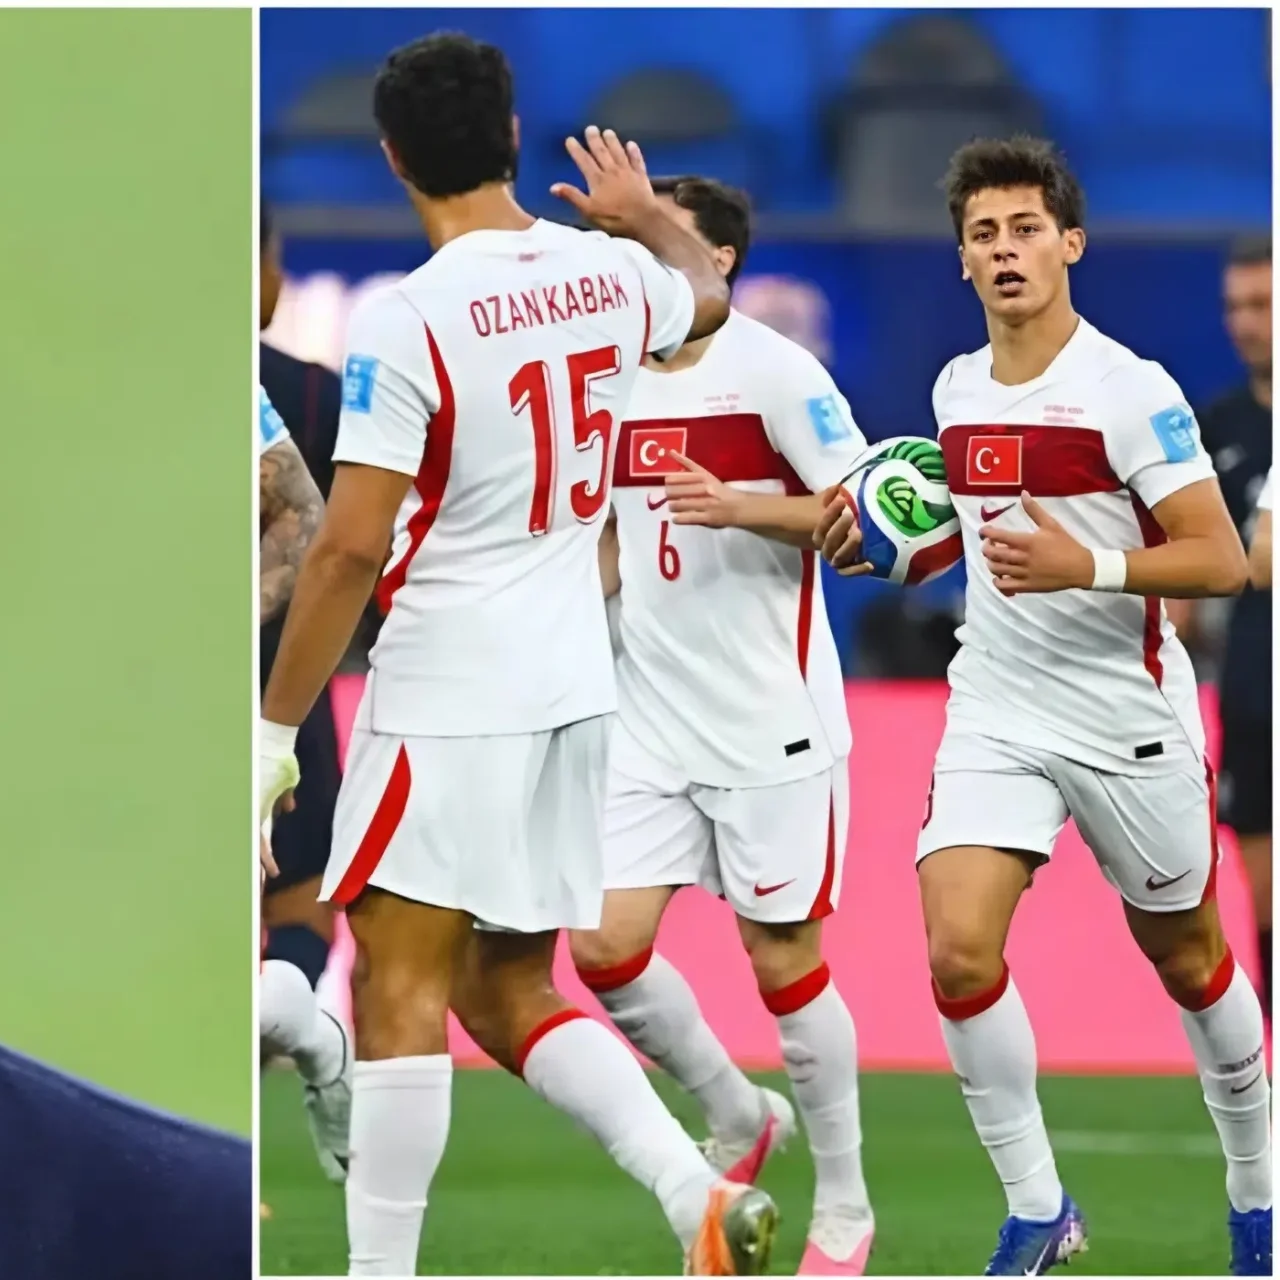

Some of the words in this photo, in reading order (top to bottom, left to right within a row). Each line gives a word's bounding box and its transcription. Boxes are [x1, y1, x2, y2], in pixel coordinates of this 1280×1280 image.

[470, 288, 545, 337] OZAN
[543, 272, 629, 325] KABAK
[508, 345, 621, 537] 15
[659, 519, 681, 582] 6
